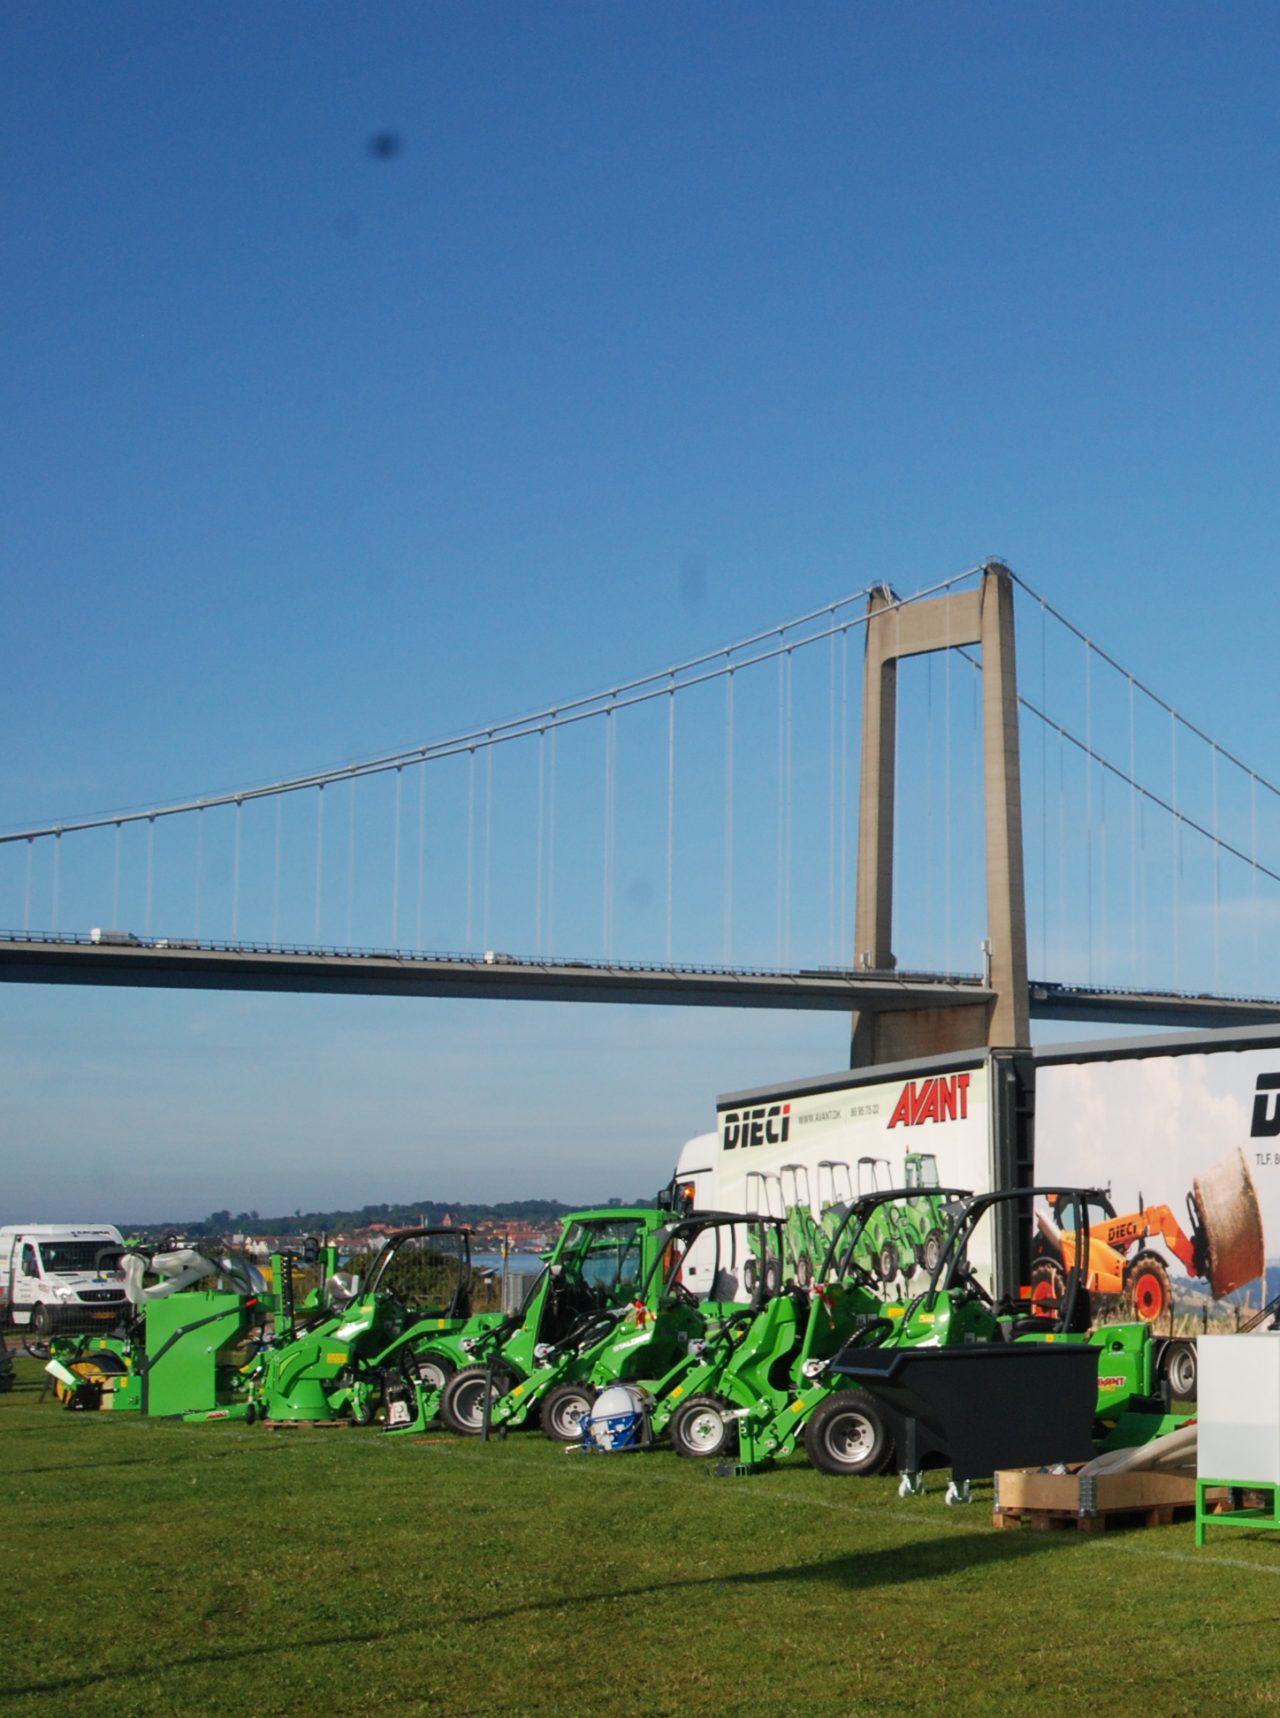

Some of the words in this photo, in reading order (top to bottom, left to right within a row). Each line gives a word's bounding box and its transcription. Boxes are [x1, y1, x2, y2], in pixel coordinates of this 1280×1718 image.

[887, 1073, 971, 1130] AVANT
[723, 1104, 791, 1150] DIECI
[1256, 1153, 1272, 1166] TLF.
